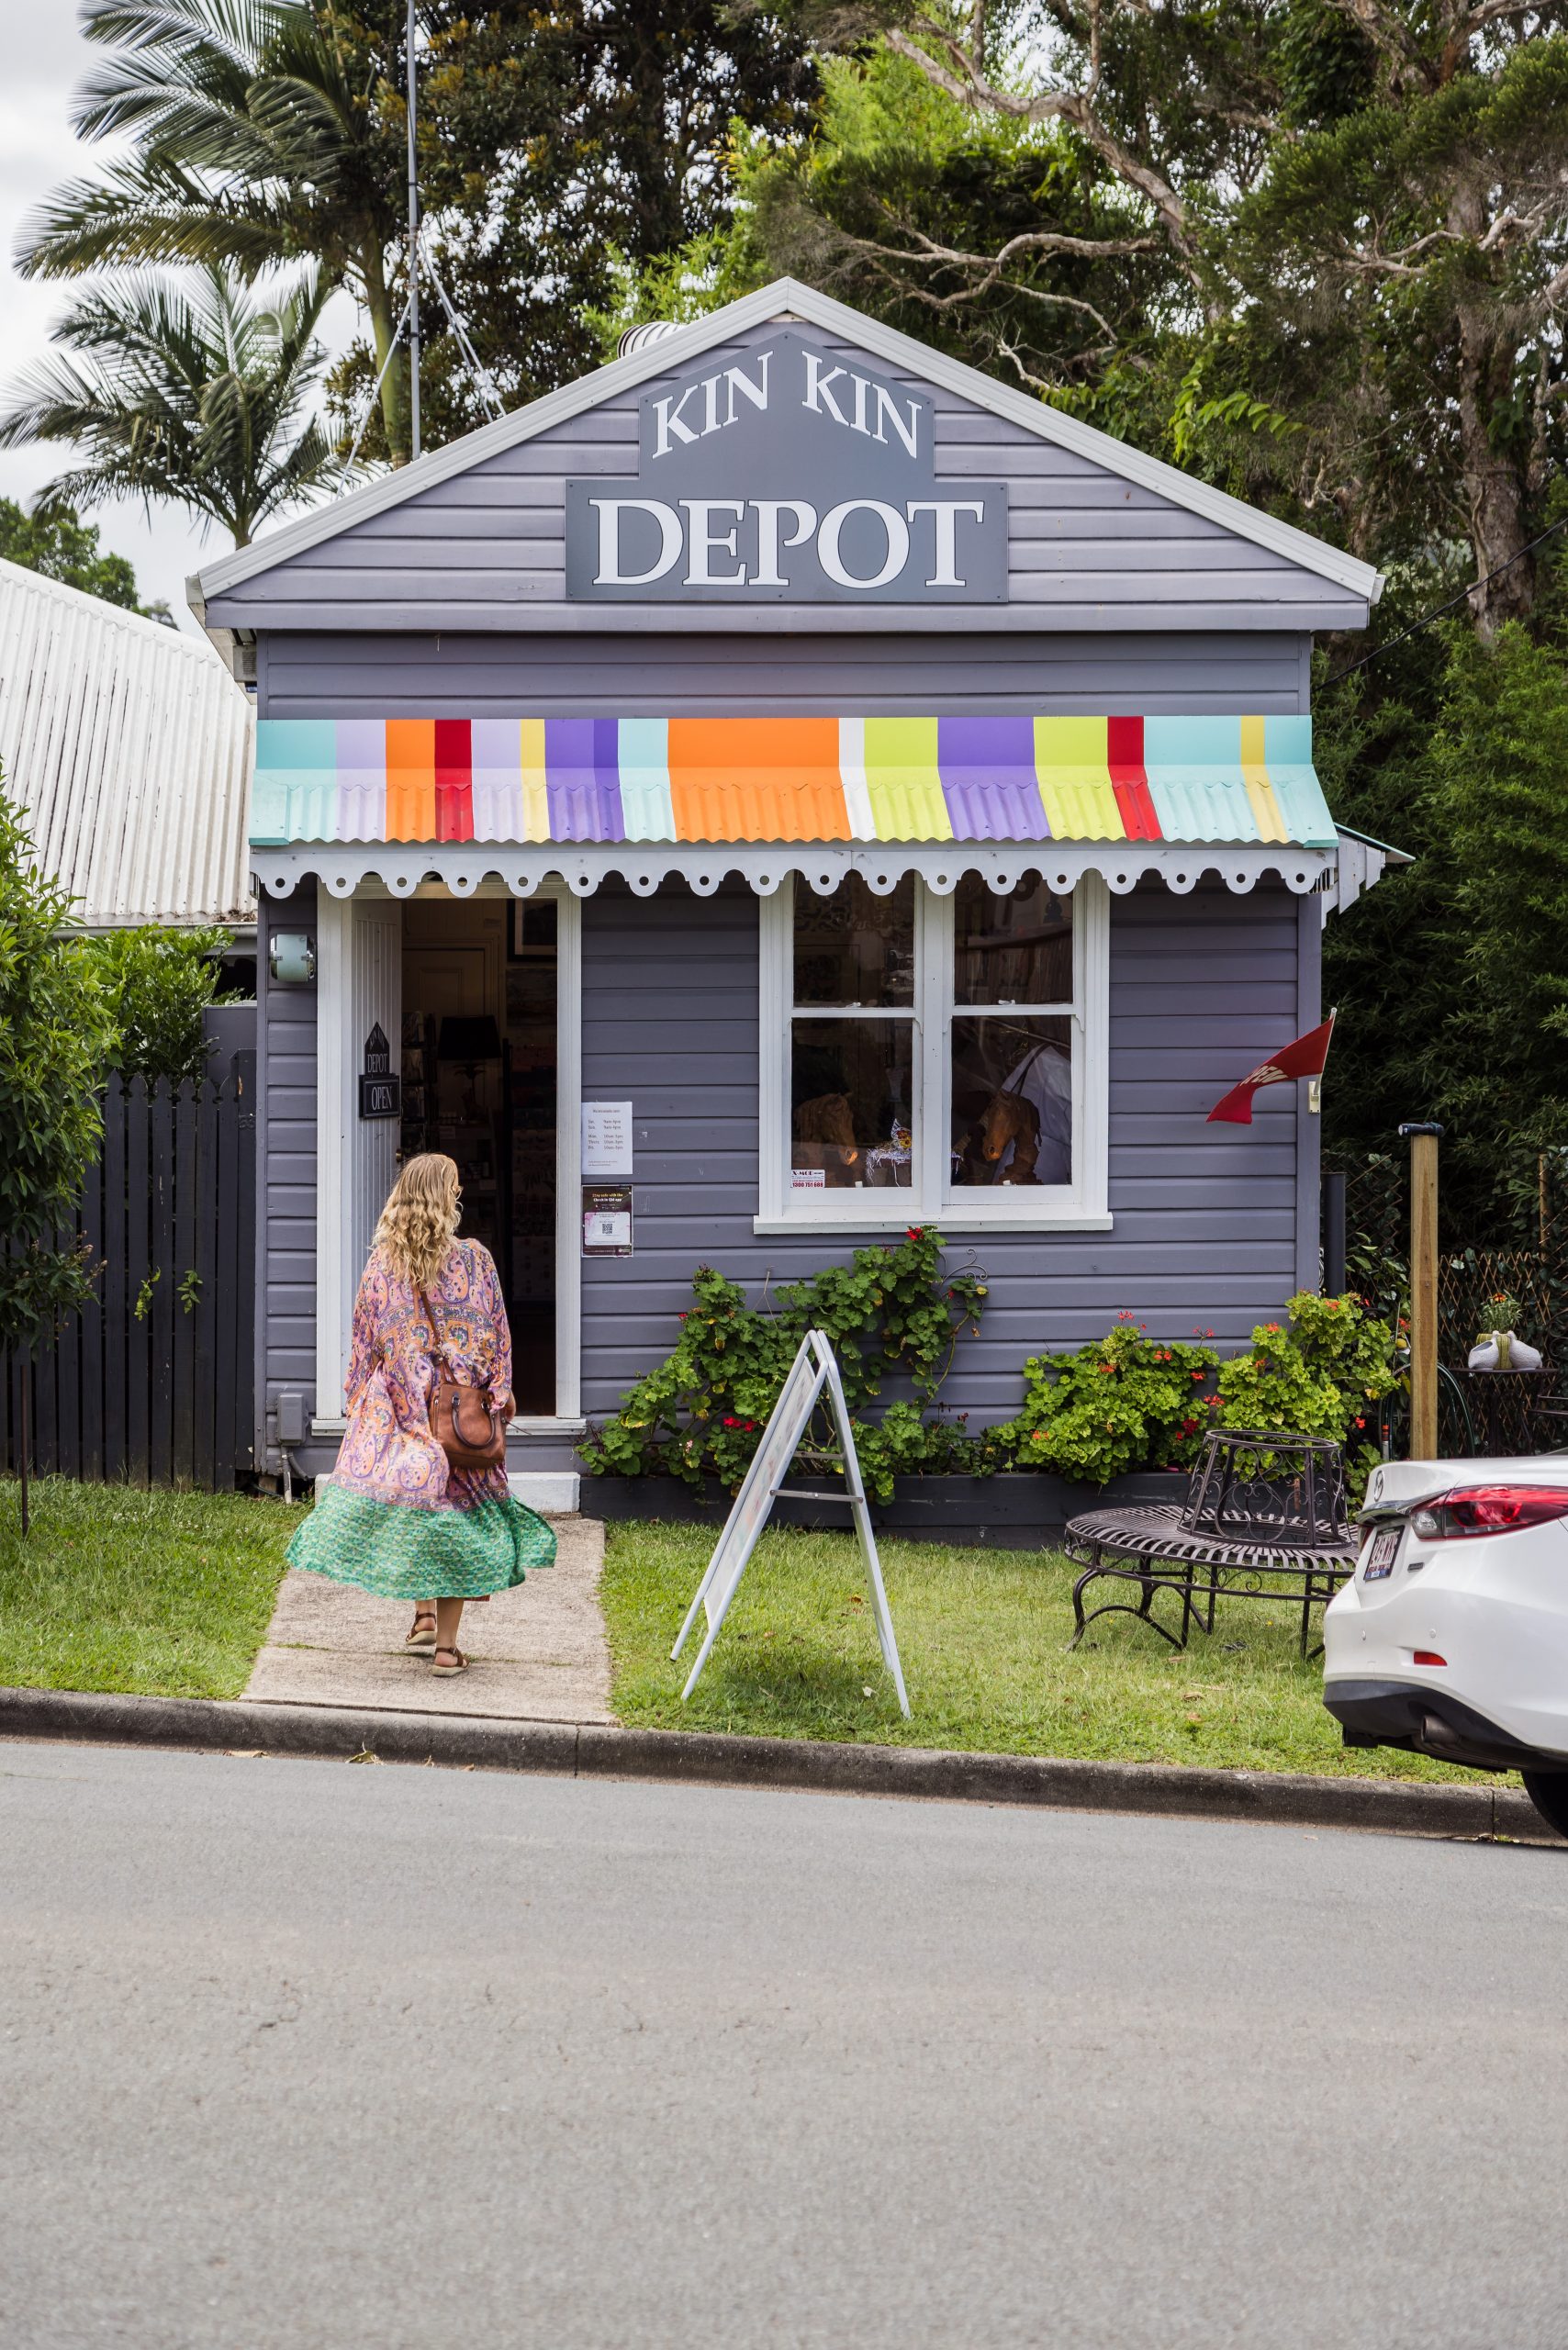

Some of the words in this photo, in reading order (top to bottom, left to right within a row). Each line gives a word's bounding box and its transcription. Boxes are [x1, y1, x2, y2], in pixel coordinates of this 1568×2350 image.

[652, 350, 774, 459] KIN
[801, 349, 923, 460] KIN
[588, 498, 986, 589] DEPOT
[367, 1053, 387, 1073] DEPOT
[371, 1086, 392, 1110] OPEN
